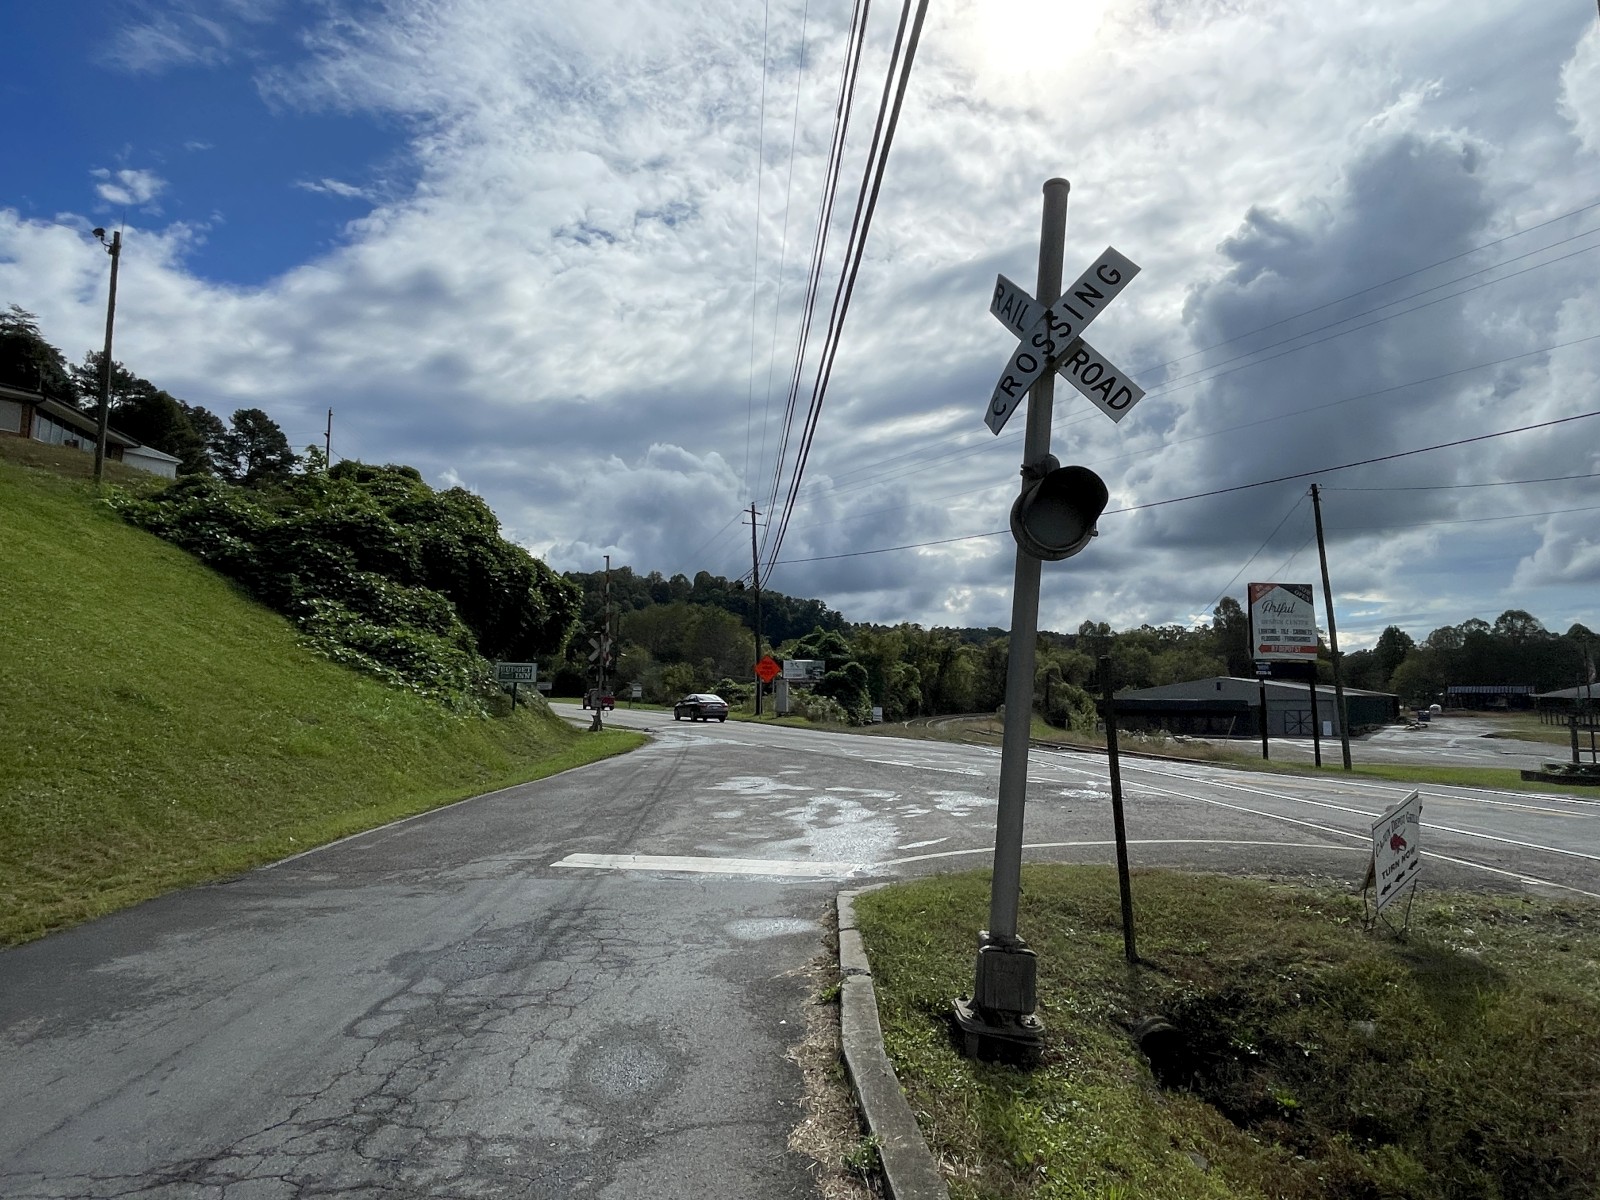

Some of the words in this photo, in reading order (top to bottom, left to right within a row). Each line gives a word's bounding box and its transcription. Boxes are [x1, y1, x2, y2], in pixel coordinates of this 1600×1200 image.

[992, 264, 1122, 417] CROSSING
[992, 283, 1029, 333] RAIL
[1064, 348, 1133, 411] ROAD
[1261, 600, 1296, 617] Artful
[1278, 645, 1294, 653] DEPOT
[1381, 859, 1400, 880] TURN
[1401, 844, 1416, 864] NOW
